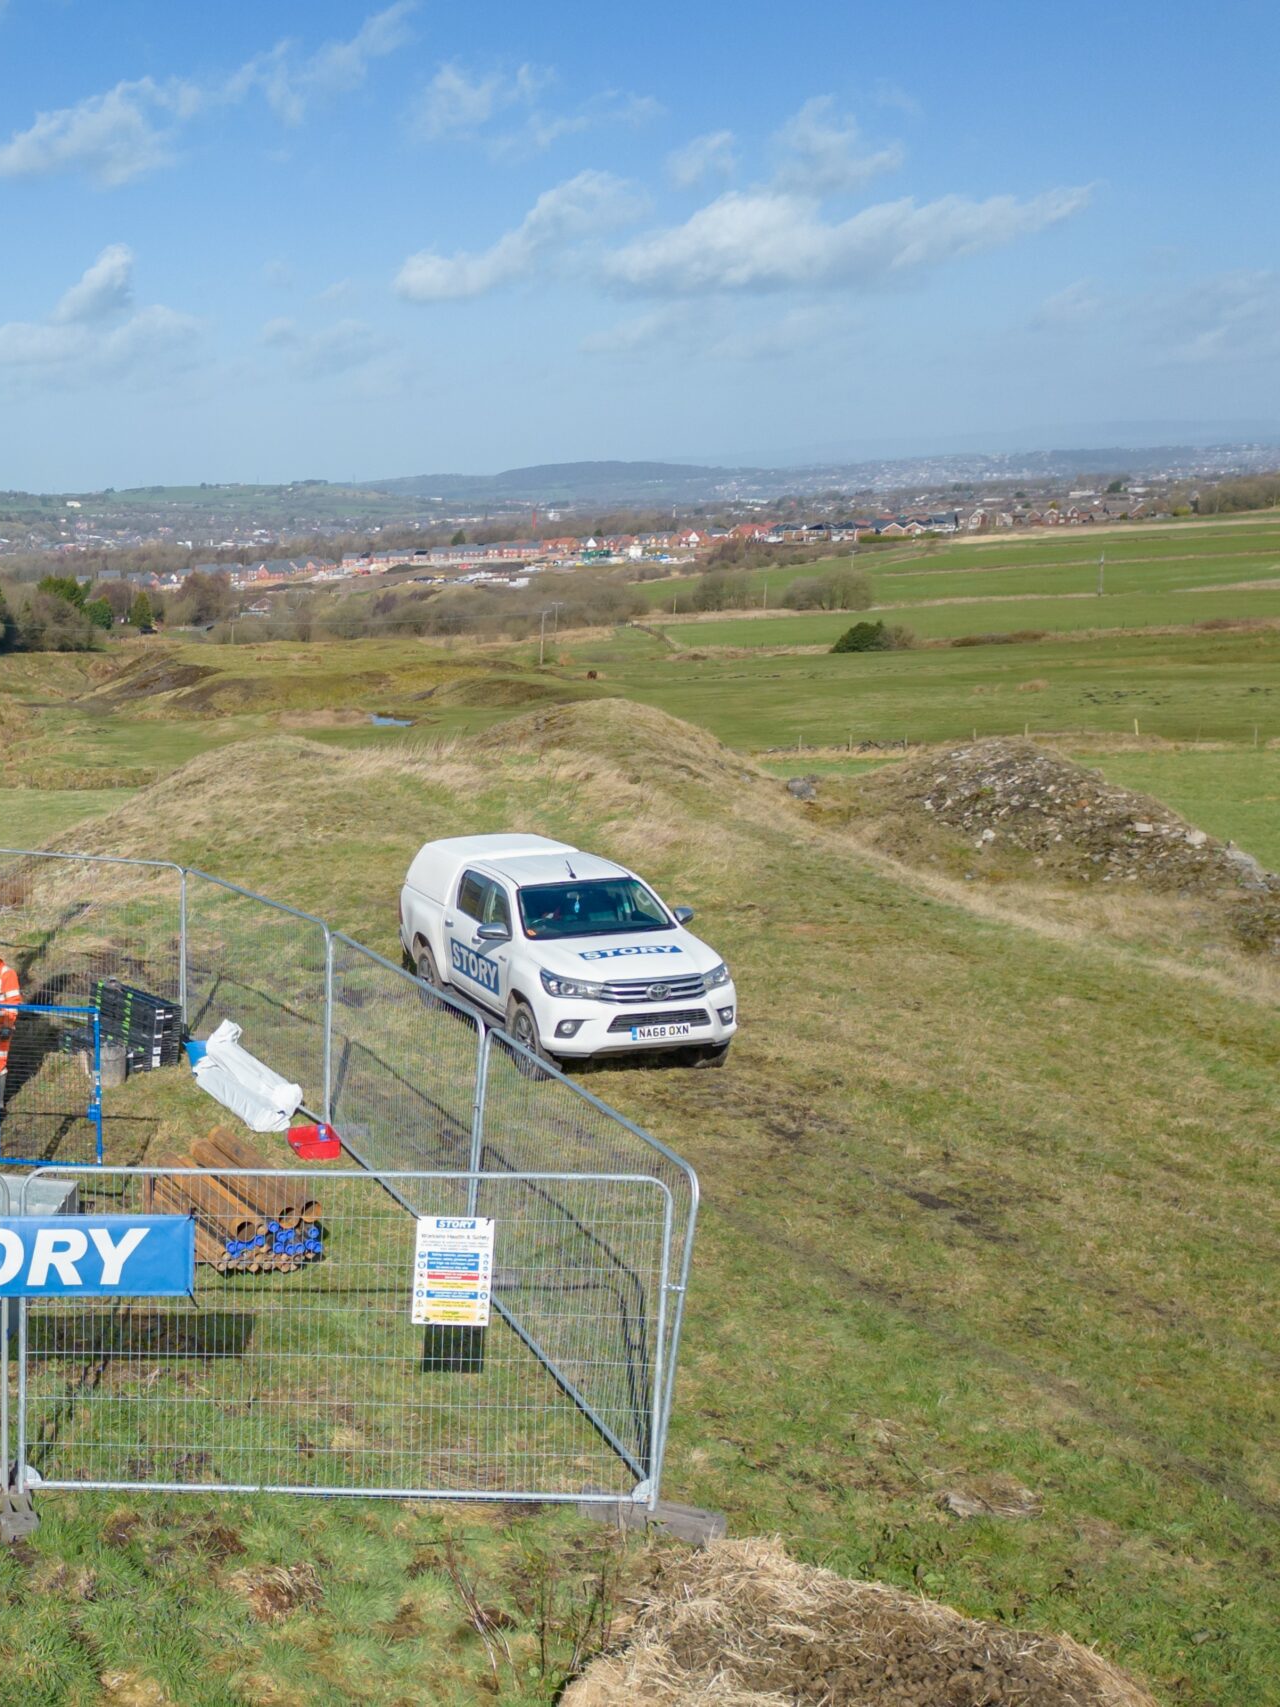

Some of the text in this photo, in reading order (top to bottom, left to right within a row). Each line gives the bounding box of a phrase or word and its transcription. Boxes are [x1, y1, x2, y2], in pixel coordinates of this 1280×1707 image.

[583, 945, 673, 960] STORY
[452, 942, 497, 989] STORY
[639, 1025, 689, 1038] NA68 OXN
[439, 1220, 474, 1229] STORY
